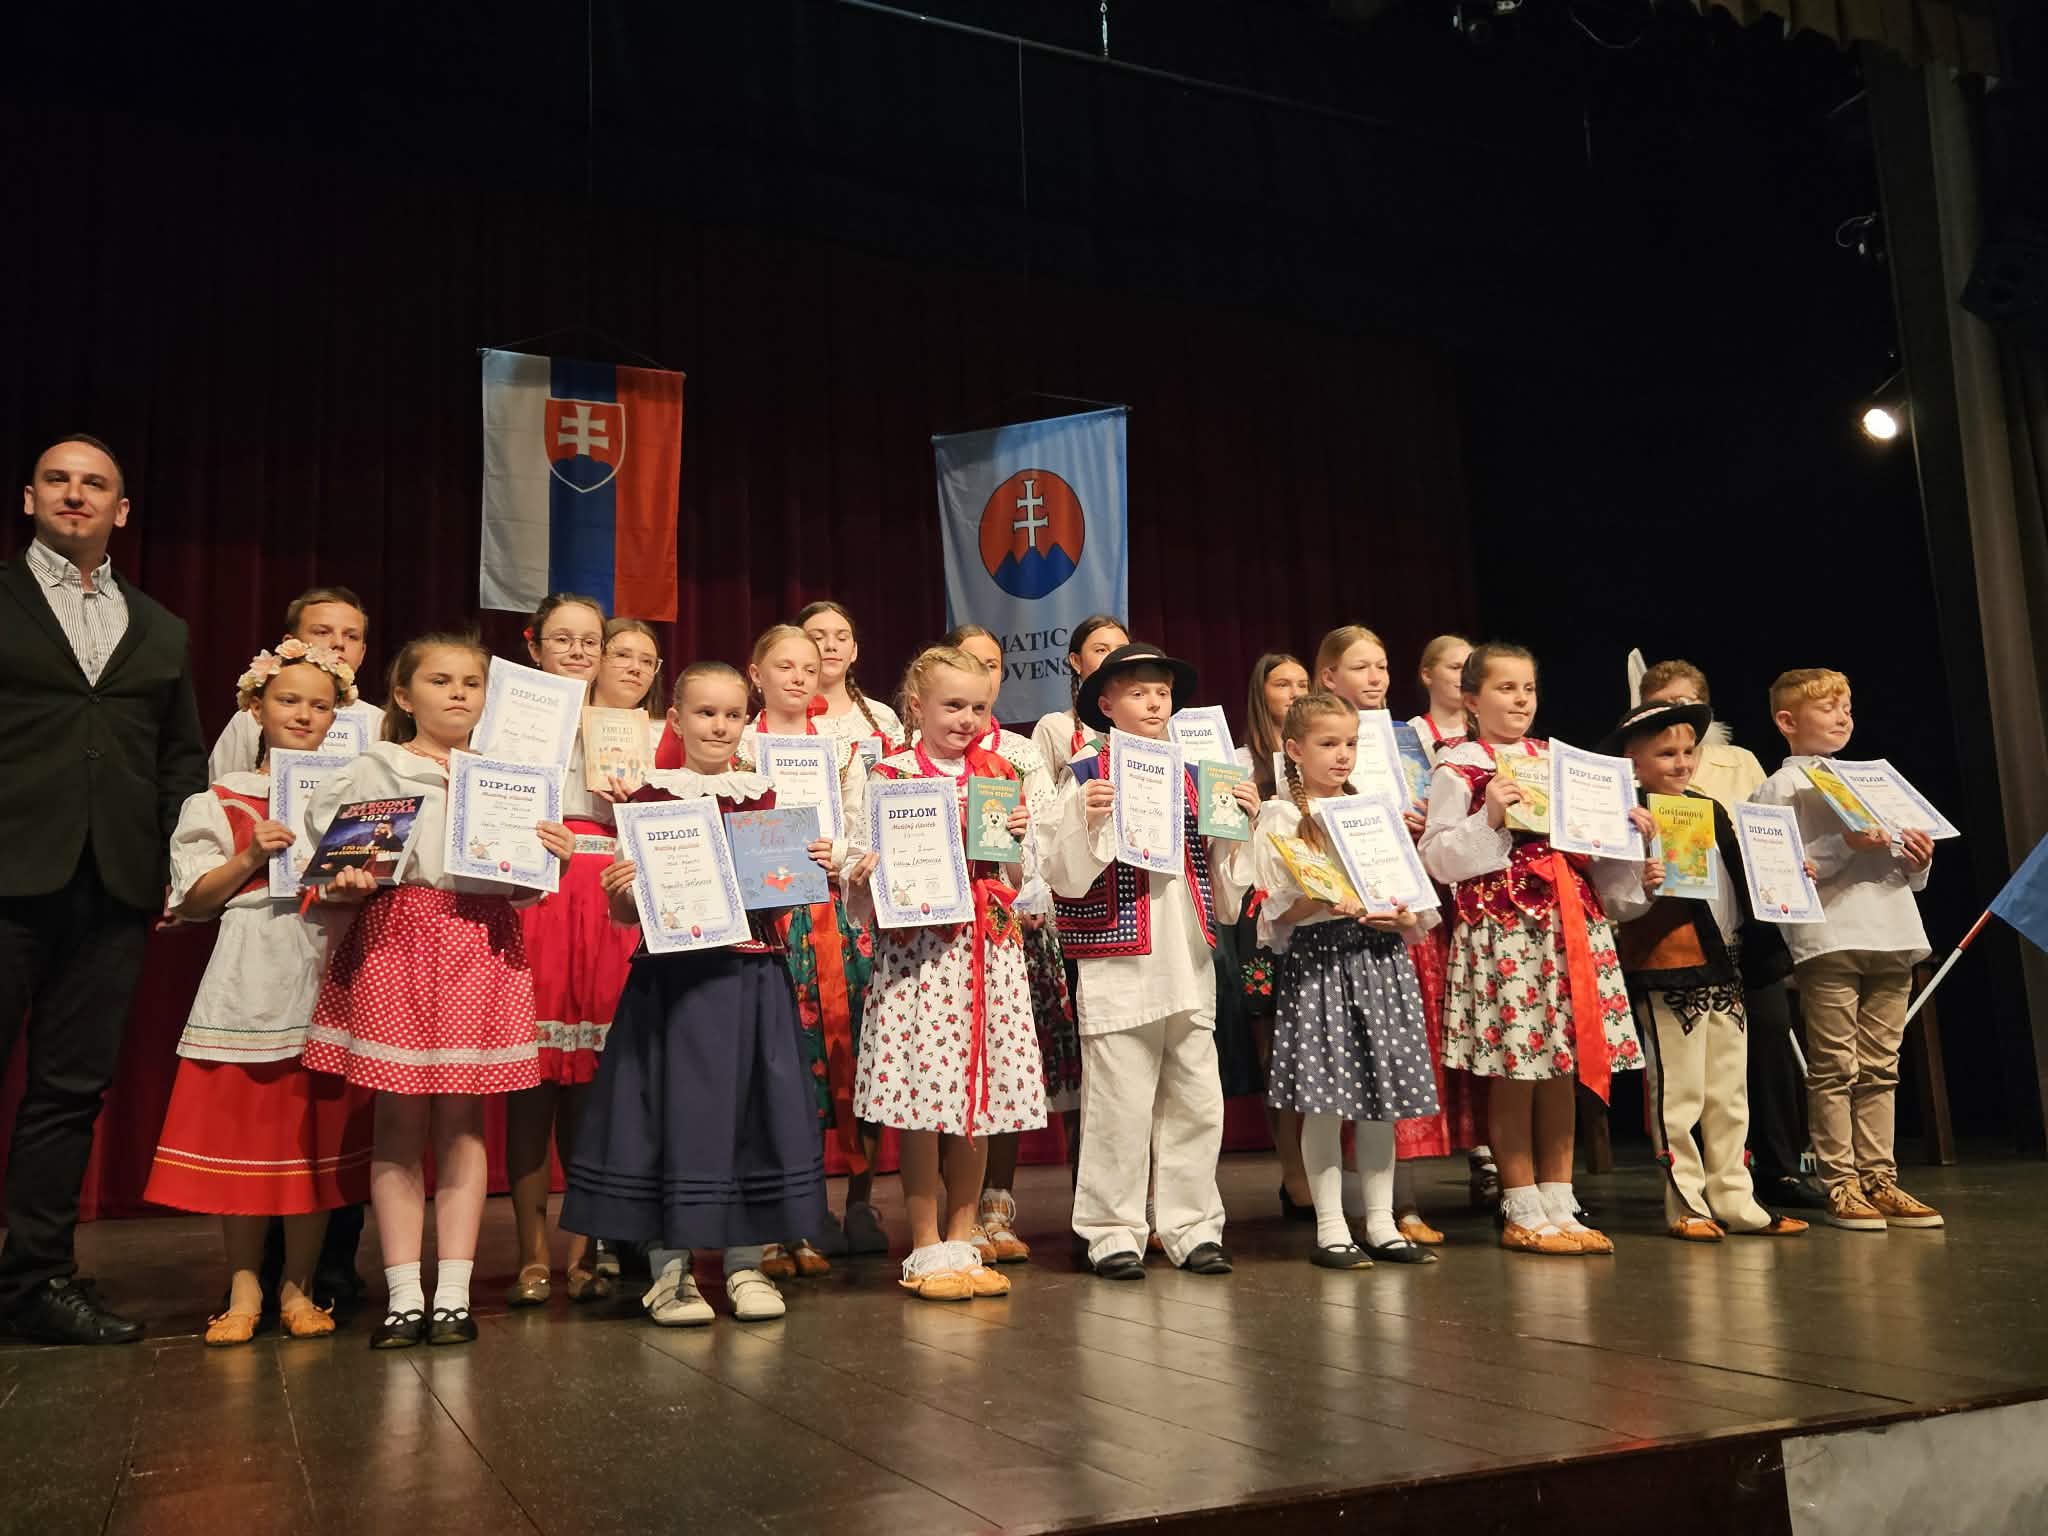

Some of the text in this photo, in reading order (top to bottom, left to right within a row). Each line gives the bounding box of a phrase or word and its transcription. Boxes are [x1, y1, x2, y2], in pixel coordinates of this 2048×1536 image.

[510, 687, 560, 707] DIPLOM
[1180, 728, 1213, 737] DIPLOM
[776, 758, 819, 767] DIPLOM
[1127, 759, 1165, 776] DIPLOM
[1568, 767, 1613, 783] DIPLOM
[480, 779, 536, 794] DIPLOM
[888, 807, 937, 820] DIPLOM
[1341, 815, 1382, 829] DIPLOM
[648, 827, 700, 841] DIPLOM
[1749, 825, 1783, 837] DIPLOM
